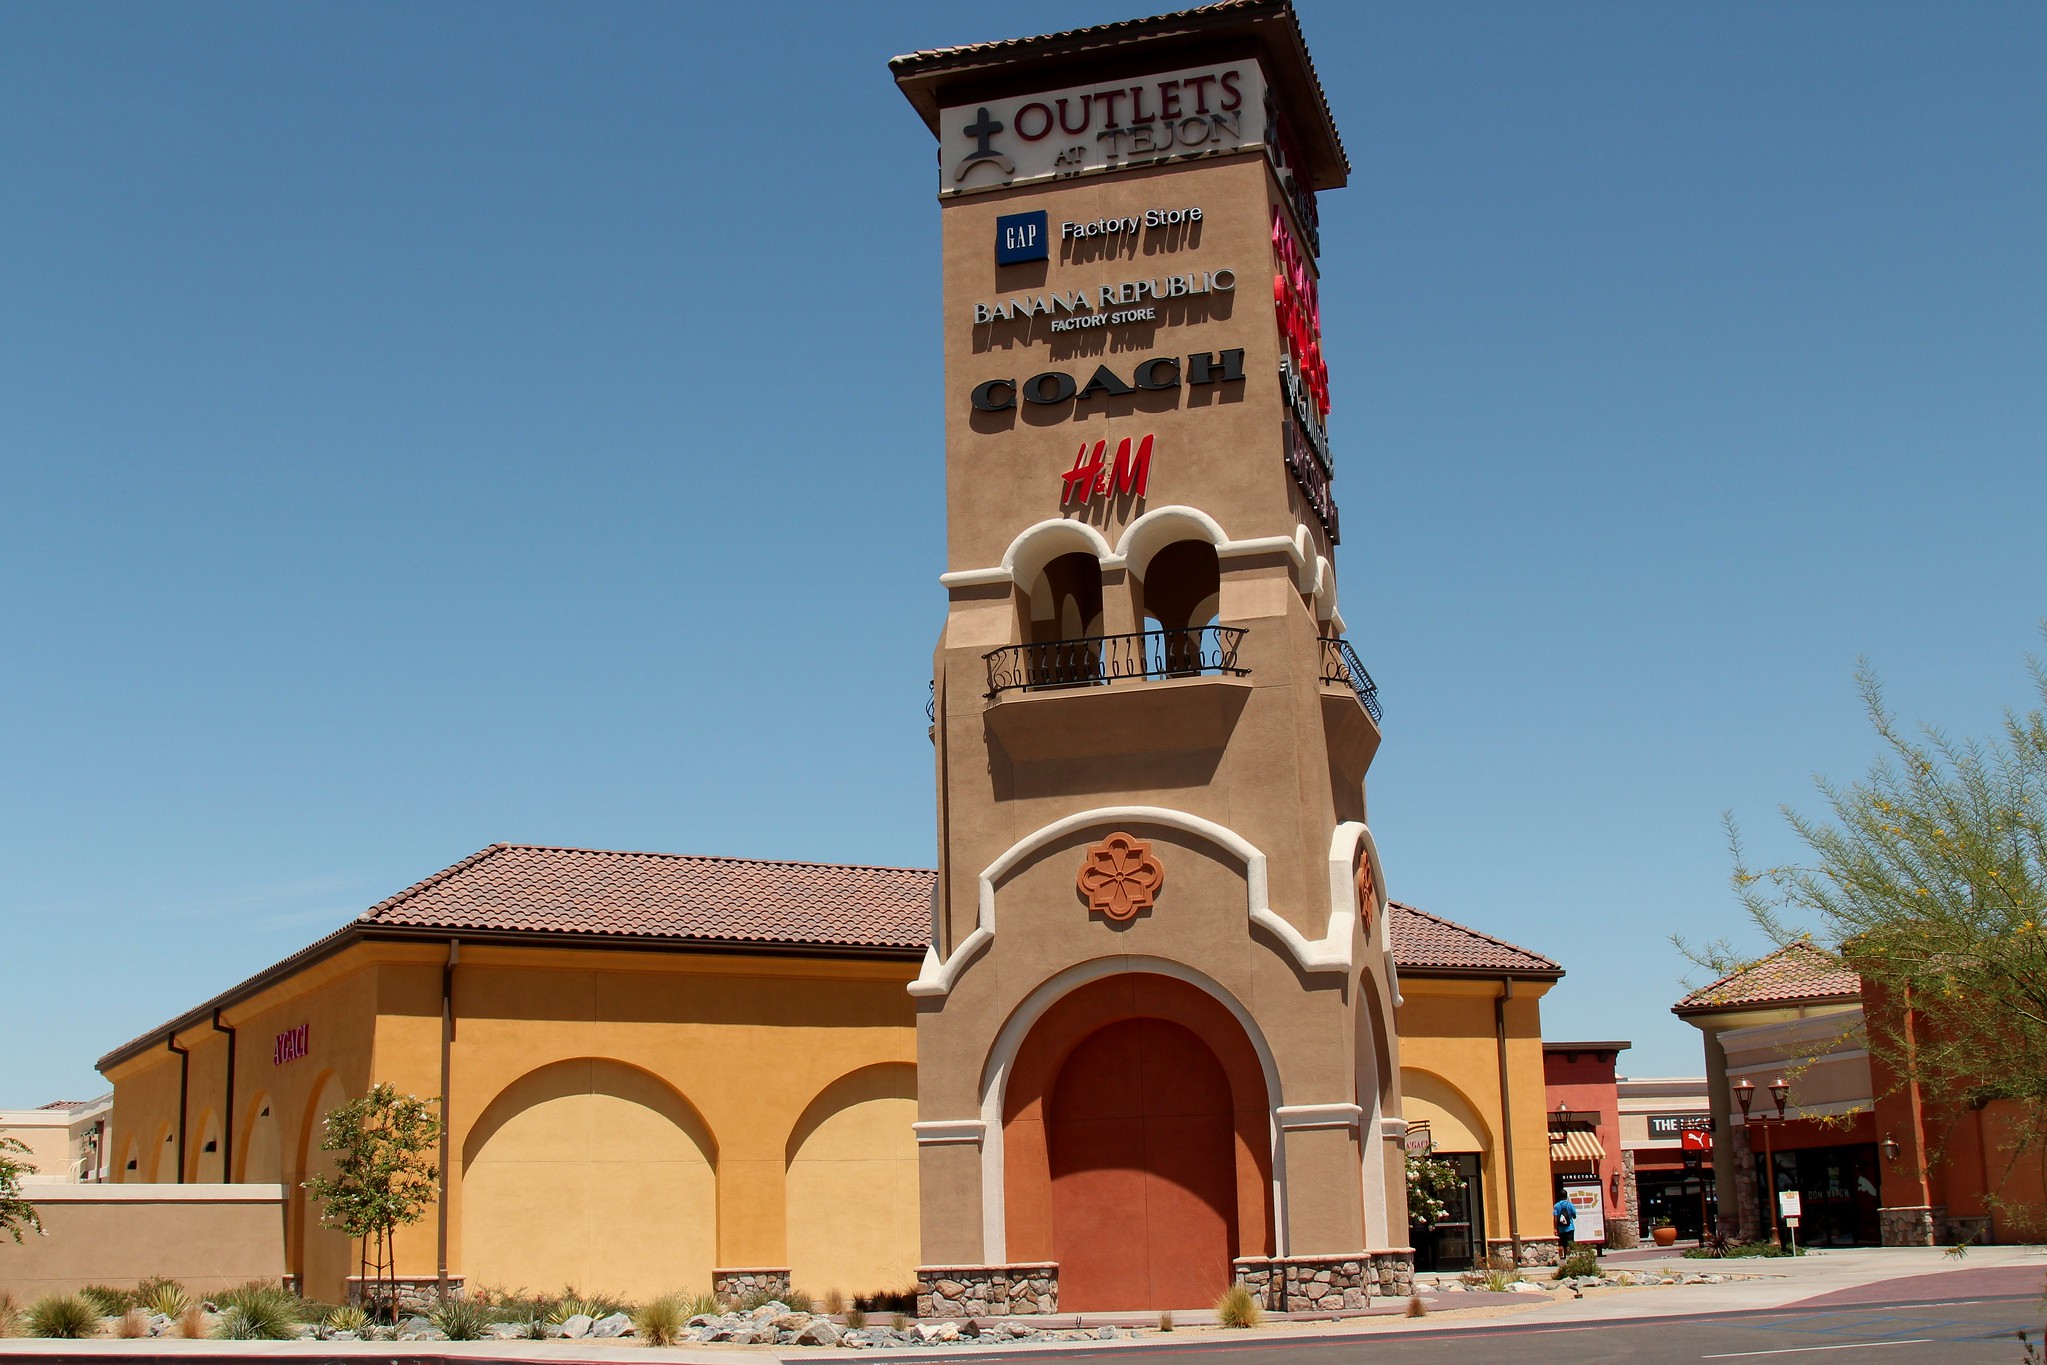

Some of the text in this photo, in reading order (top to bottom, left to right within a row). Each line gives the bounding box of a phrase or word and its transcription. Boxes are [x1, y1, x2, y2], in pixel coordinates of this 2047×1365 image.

[1013, 69, 1242, 142] OUTLETS
[1053, 110, 1242, 168] AT TEJON
[1006, 223, 1037, 250] GAP
[1061, 205, 1203, 240] Factory Store
[973, 268, 1236, 325] BANANA REPUBLIC
[1050, 307, 1156, 333] FACTORY STORE
[970, 347, 1246, 412] COACH
[1061, 433, 1156, 506] H&M
[273, 1024, 309, 1065] A'GACI
[1653, 1119, 1678, 1131] THE
